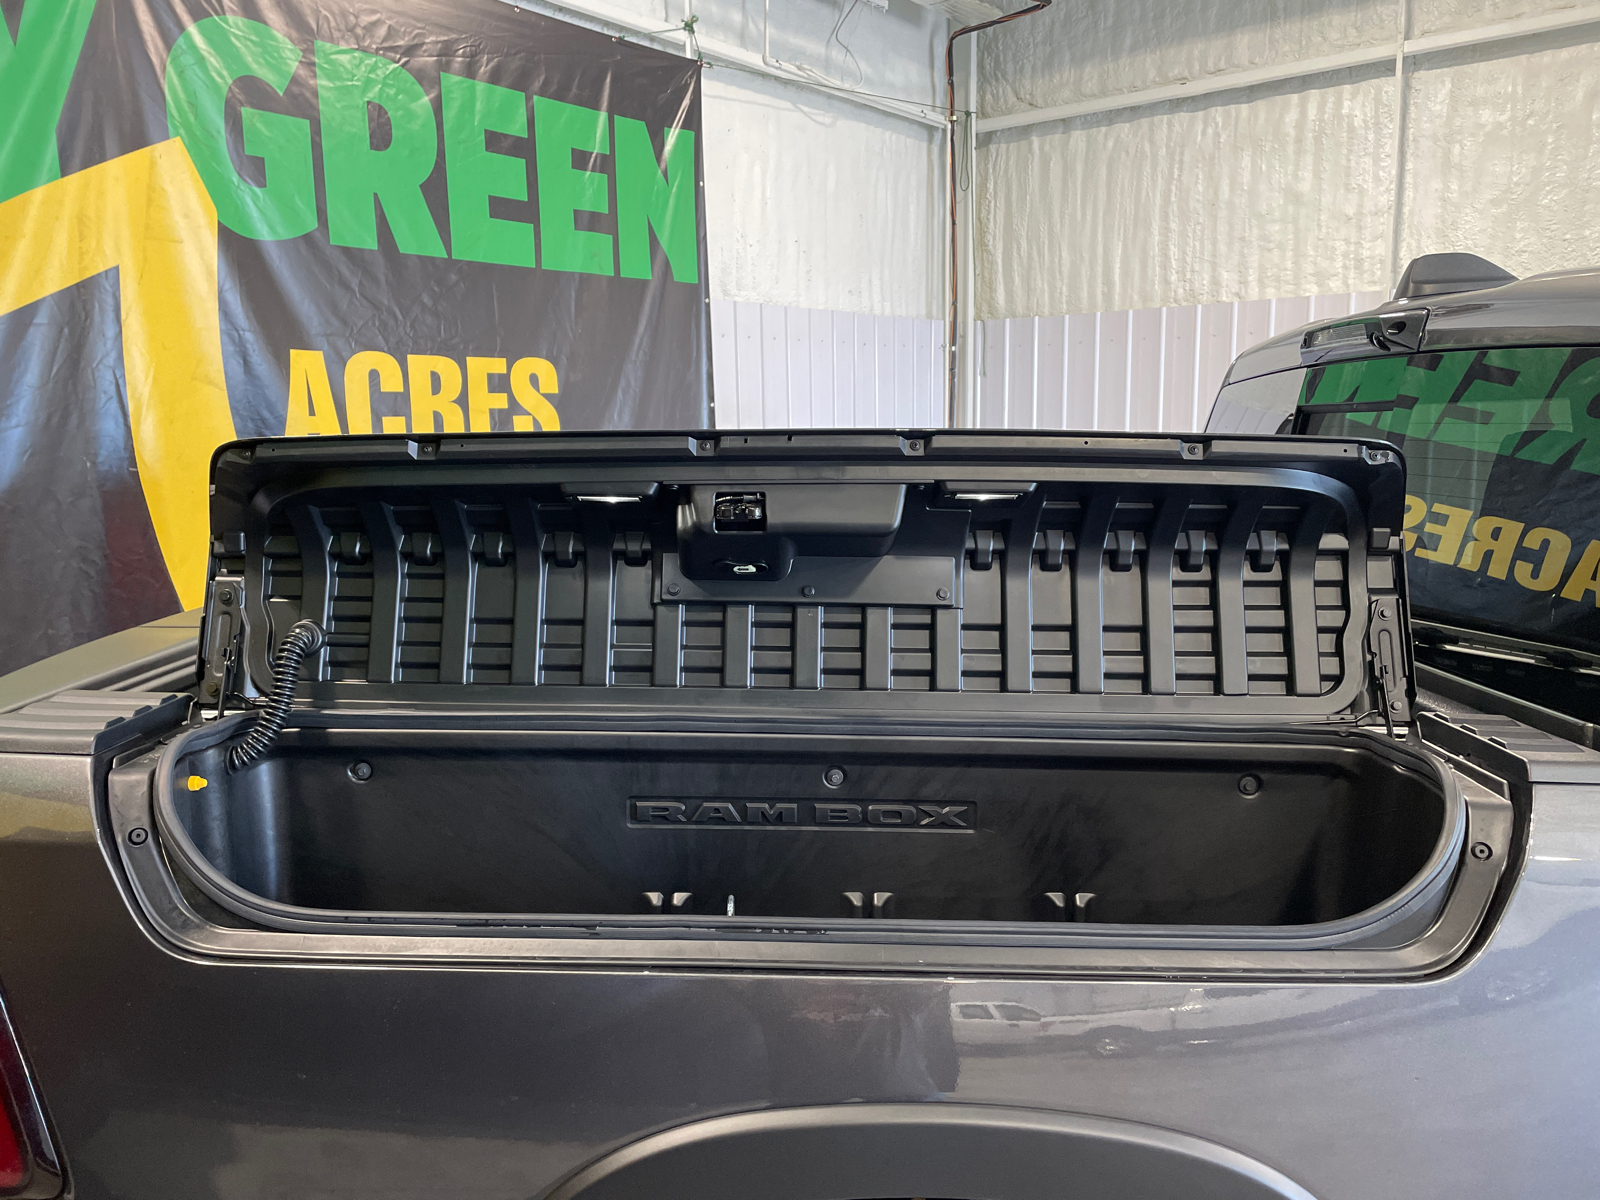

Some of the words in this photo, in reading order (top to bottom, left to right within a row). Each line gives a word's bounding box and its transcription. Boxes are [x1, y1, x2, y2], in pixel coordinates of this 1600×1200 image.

[166, 15, 699, 284] GREEN
[284, 348, 561, 437] ACRES
[634, 800, 798, 824] RAM
[813, 803, 969, 827] BOX
